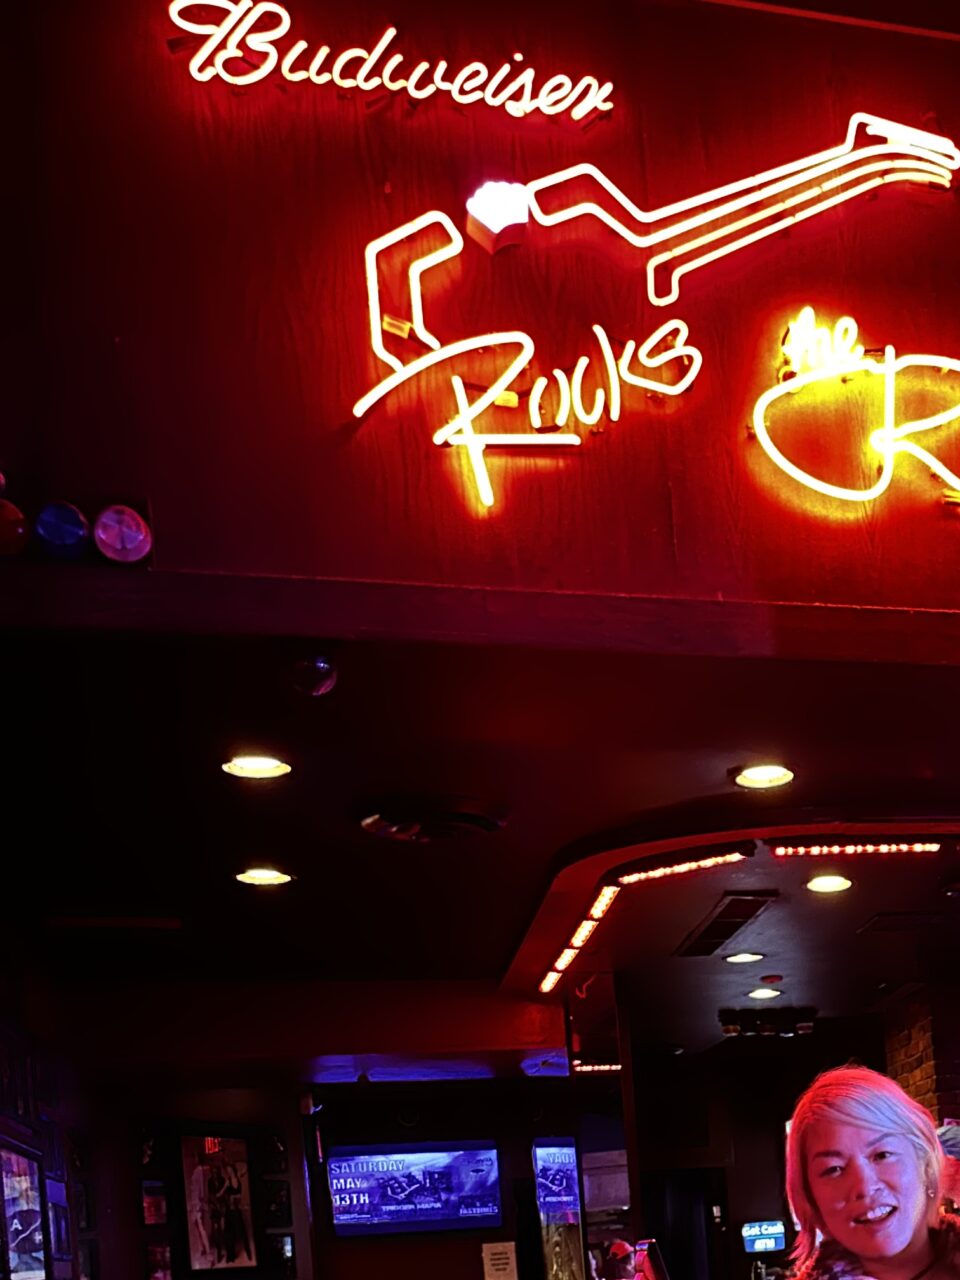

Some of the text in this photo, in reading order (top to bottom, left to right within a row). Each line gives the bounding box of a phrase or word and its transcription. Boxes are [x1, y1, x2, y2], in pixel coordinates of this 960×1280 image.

[168, 0, 615, 120] Budweiser
[331, 1159, 405, 1174] SATURDAY
[333, 1178, 362, 1190] MAY
[333, 1193, 369, 1206] 13TH
